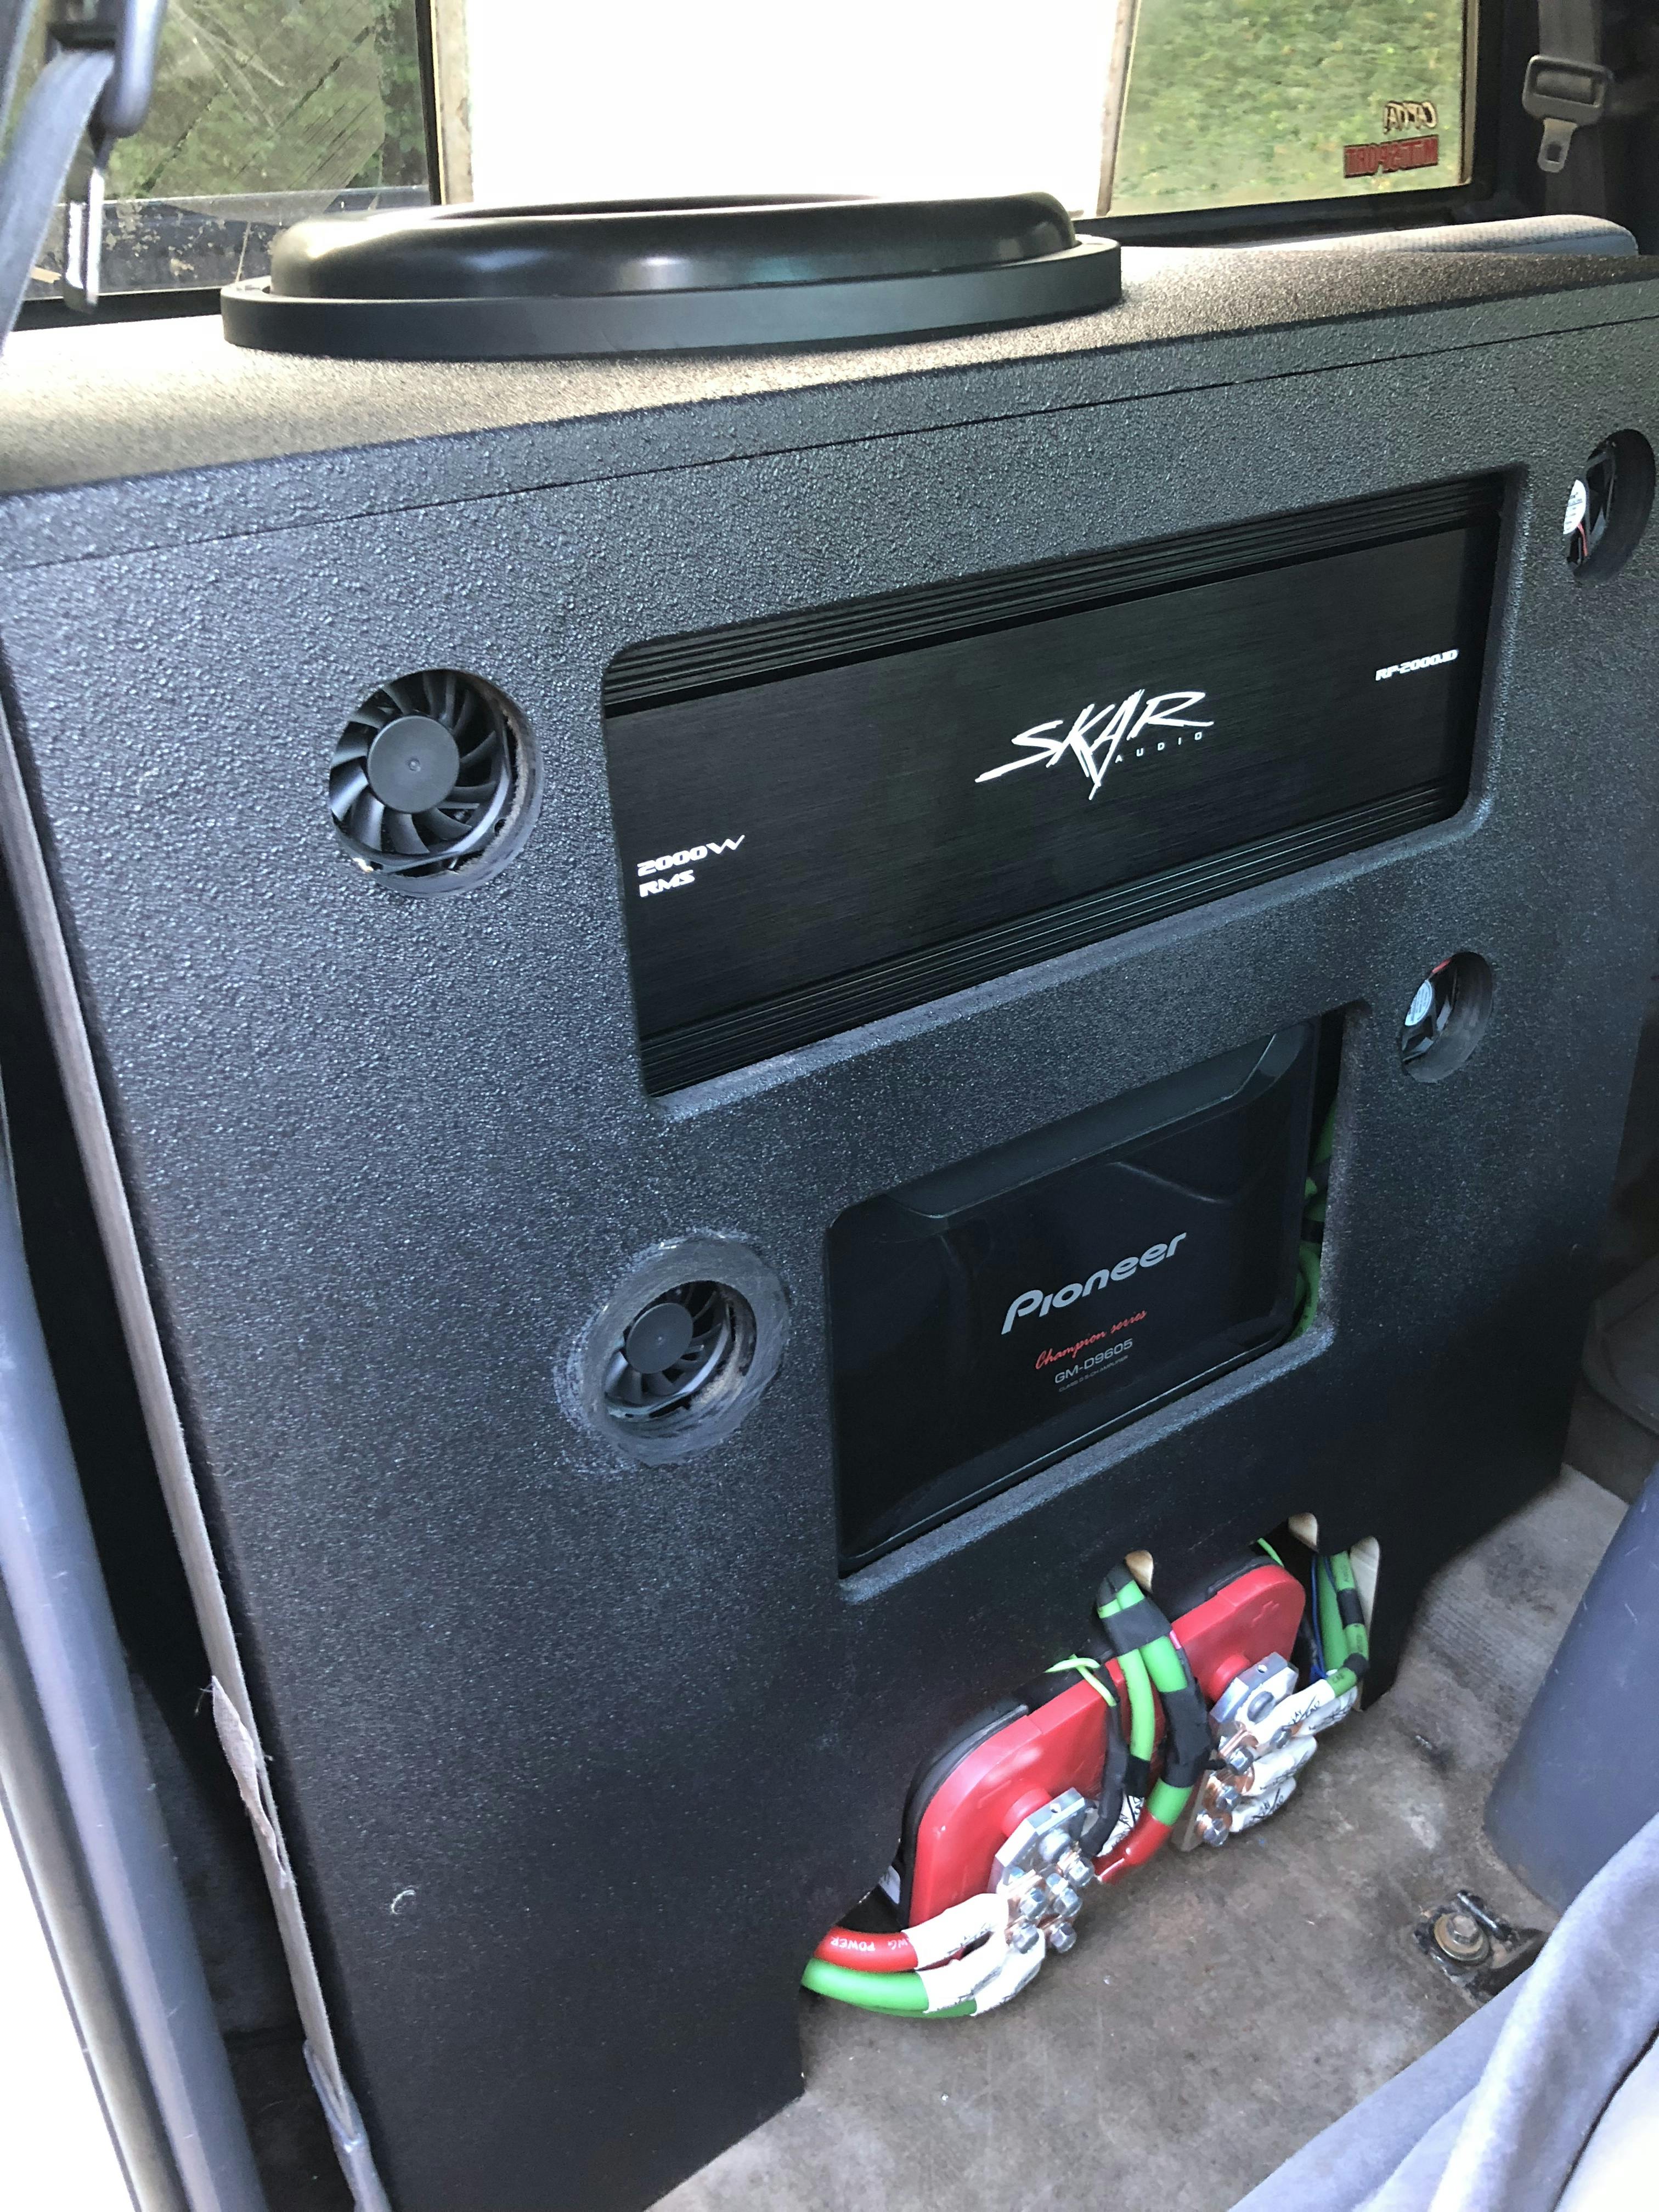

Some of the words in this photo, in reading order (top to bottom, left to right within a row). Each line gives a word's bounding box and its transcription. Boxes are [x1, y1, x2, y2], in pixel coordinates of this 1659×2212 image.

[974, 689, 1214, 800] SKAR
[1115, 731, 1202, 764] AUDIO
[637, 834, 745, 877] 2000W
[639, 870, 695, 898] RMS
[1001, 1233, 1187, 1335] Pioneer
[1035, 1332, 1107, 1370] Champion
[1054, 1338, 1133, 1384] GM-D9605
[830, 1936, 876, 1952] POWER
[887, 1938, 910, 1950] WG
